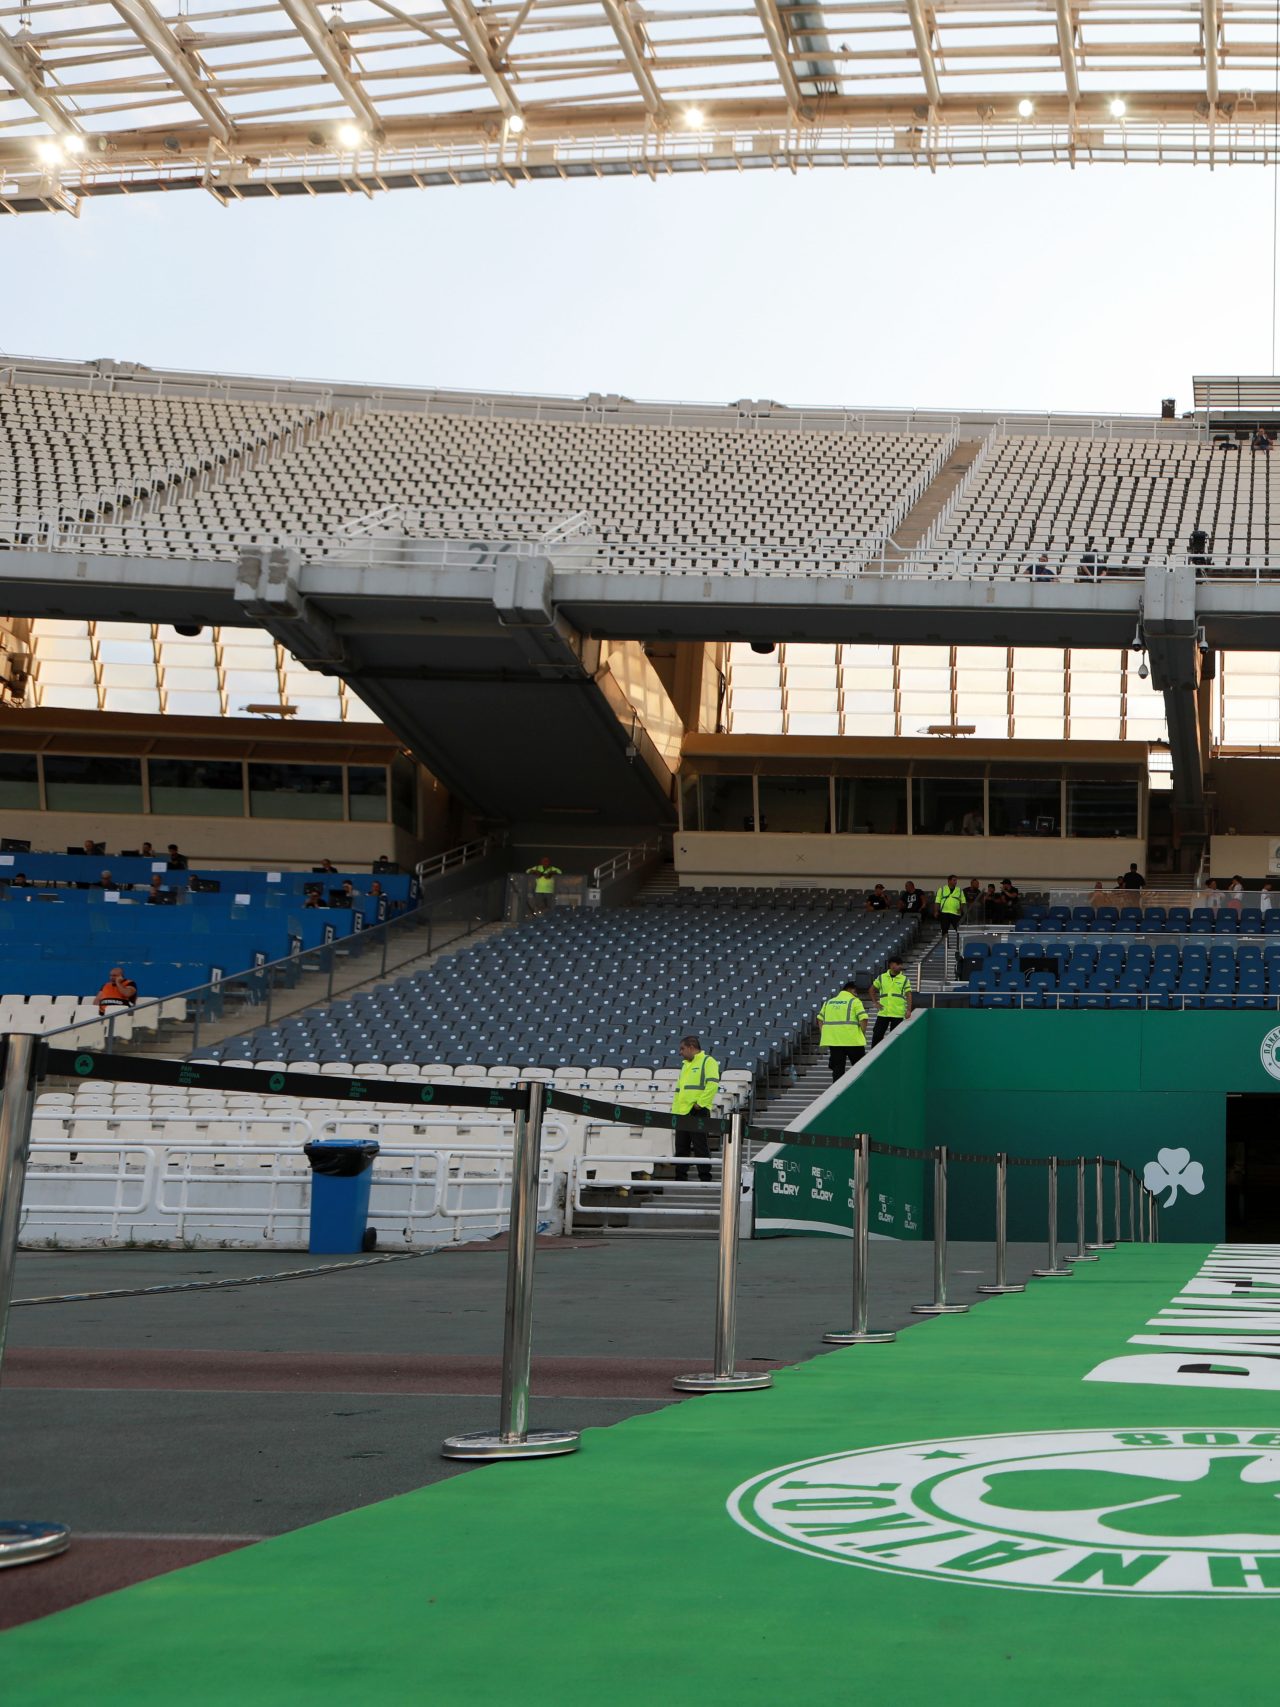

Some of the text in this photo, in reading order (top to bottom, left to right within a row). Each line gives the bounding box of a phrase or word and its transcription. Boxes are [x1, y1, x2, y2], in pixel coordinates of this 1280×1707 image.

[772, 1158, 800, 1174] RETURN
[772, 1182, 800, 1196] GLORY
[811, 1188, 834, 1202] GLORY
